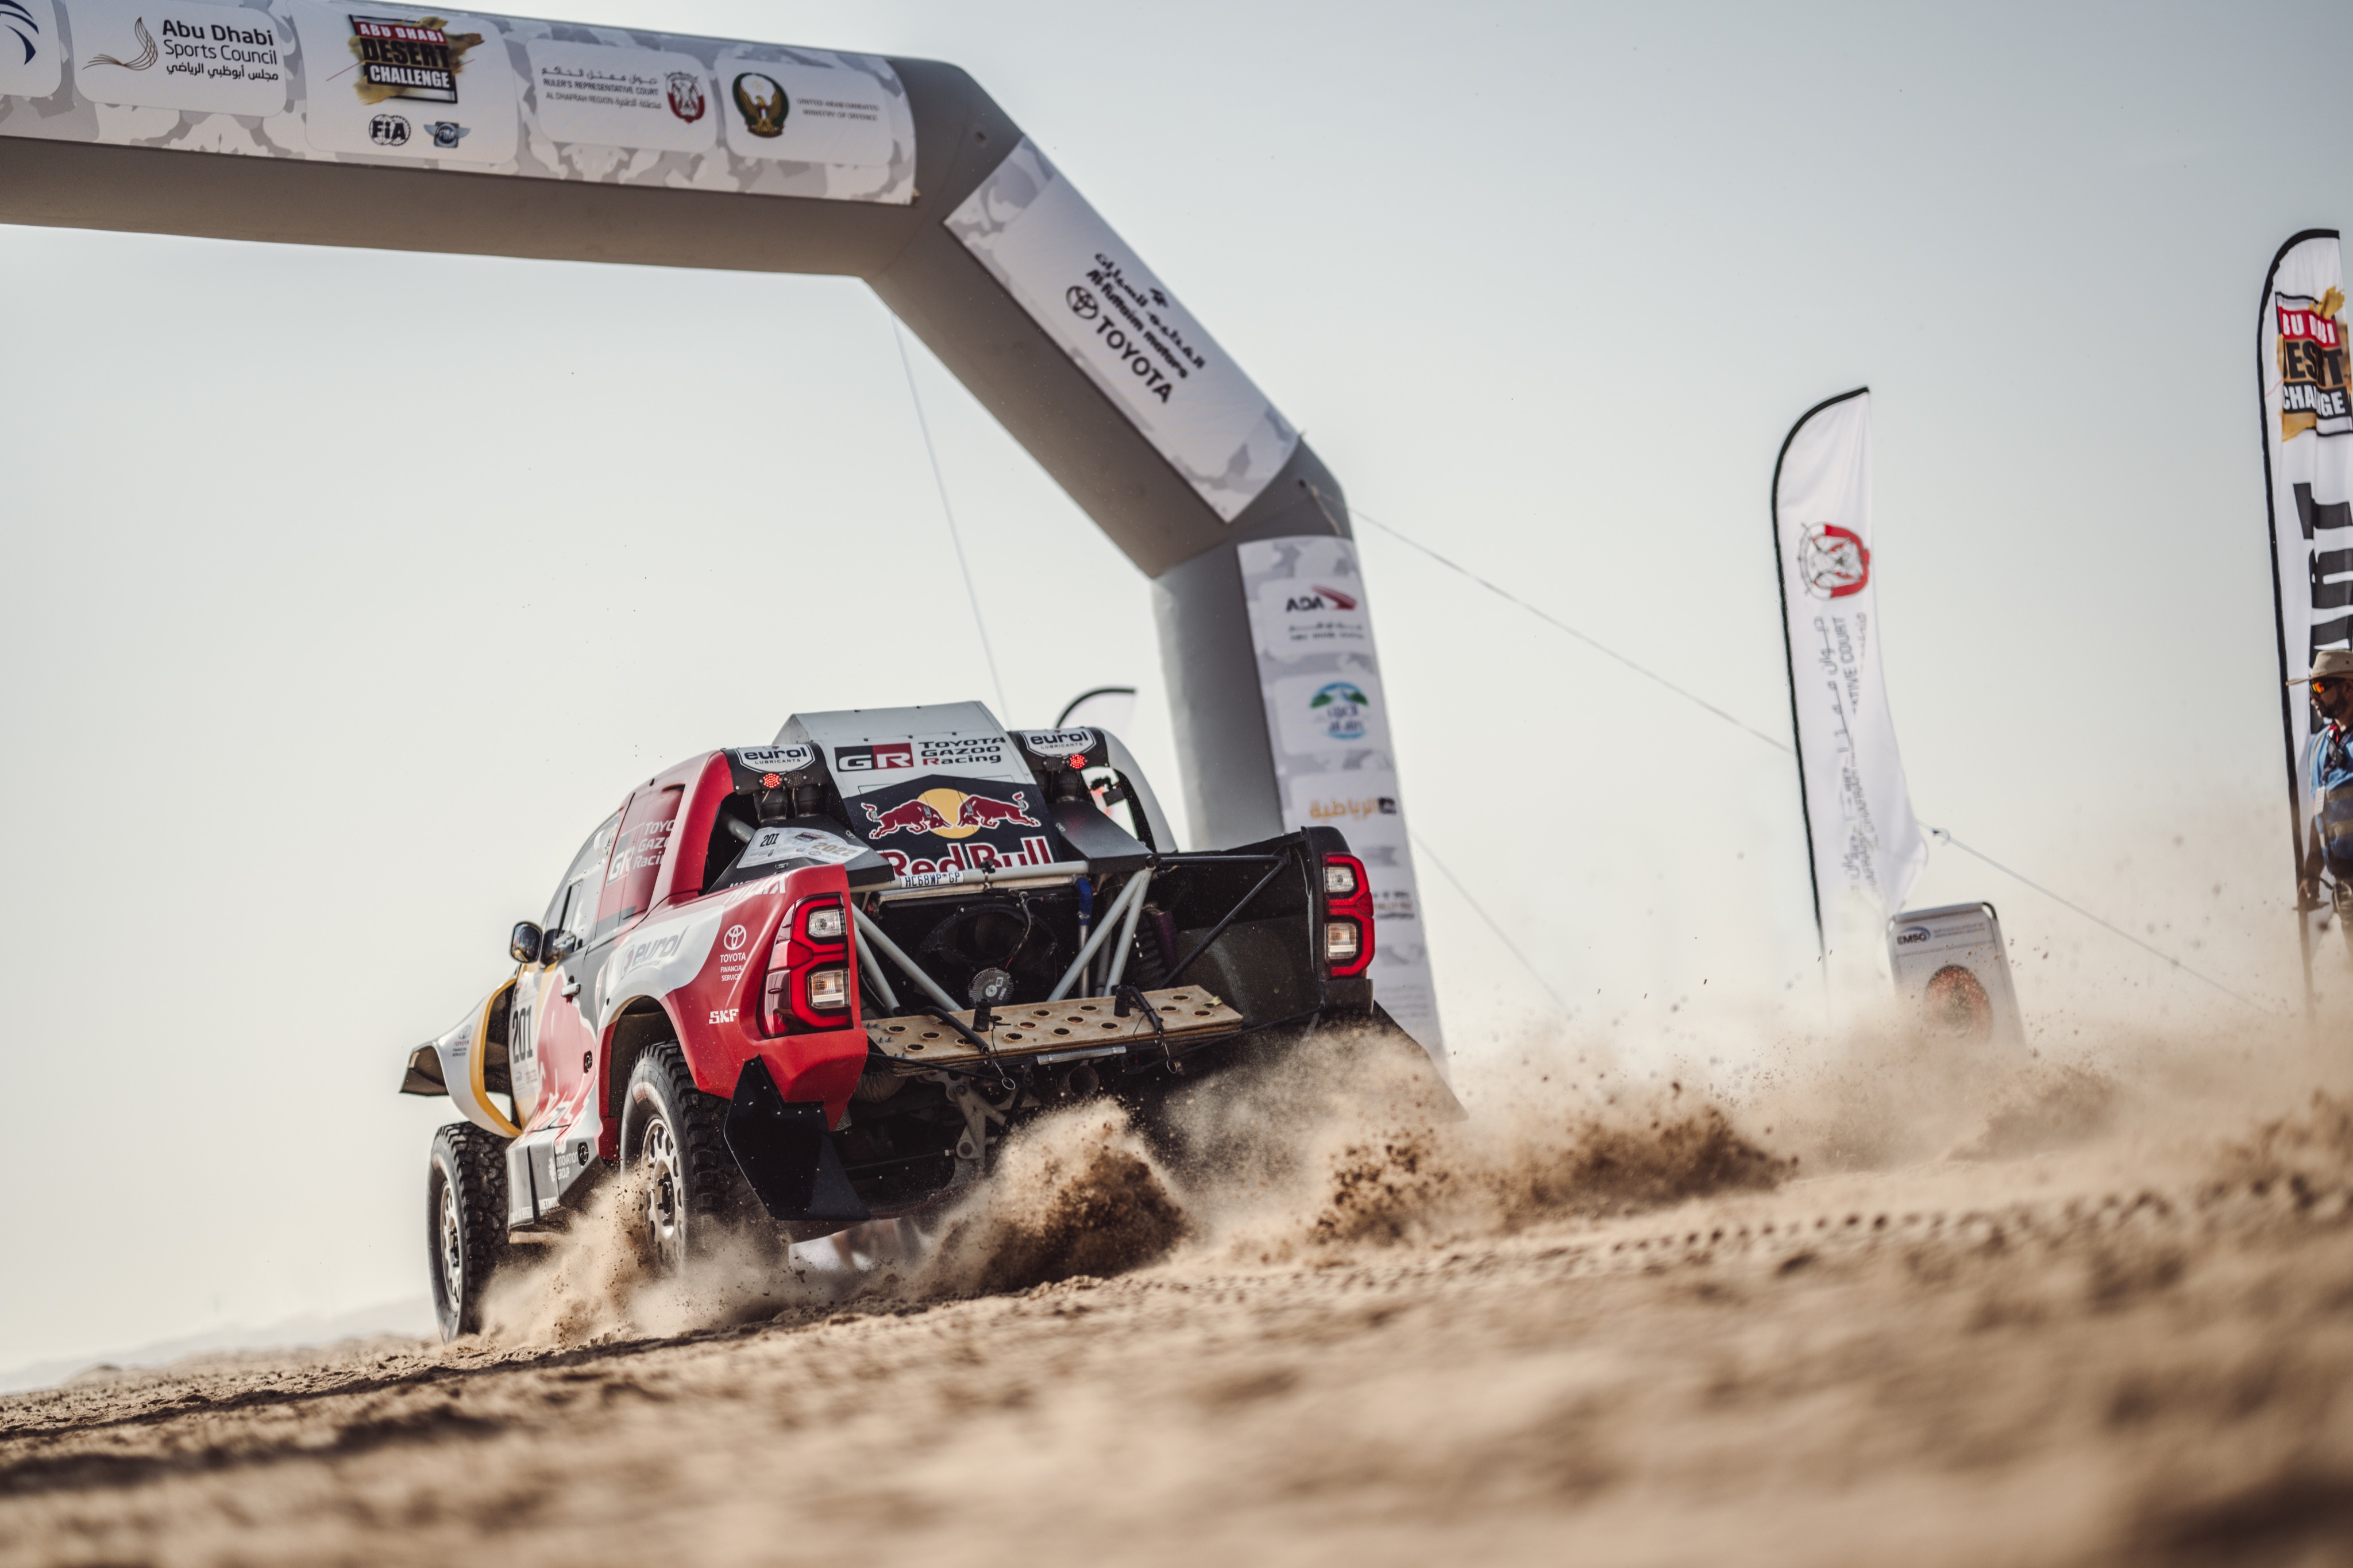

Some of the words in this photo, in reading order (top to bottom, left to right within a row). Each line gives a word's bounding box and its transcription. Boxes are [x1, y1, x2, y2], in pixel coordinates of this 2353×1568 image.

[163, 20, 205, 39] Abu
[211, 25, 274, 46] Dhabi
[360, 24, 391, 37] ABU
[395, 26, 445, 42] DHABI
[164, 39, 217, 59] Sports
[221, 45, 277, 65] Council
[360, 37, 450, 68] DESERT
[166, 61, 204, 76] الرياضي
[248, 69, 279, 82] مجلس
[369, 65, 450, 88] CHALLENGE
[635, 87, 659, 96] COURT
[1097, 315, 1172, 403] TOYOTA
[918, 736, 1006, 748] TOYOTA
[1030, 731, 1089, 745] eurol
[744, 747, 807, 760] eurol
[920, 746, 1001, 757] GAZOO
[838, 752, 912, 771] GR
[923, 755, 1001, 766] Racing
[759, 833, 780, 847] 201
[812, 842, 858, 857] 2022
[949, 872, 961, 883] GP
[720, 952, 746, 963] TOYOTA
[720, 965, 744, 973] FINANCIAL
[708, 1008, 739, 1024] SKF
[512, 1005, 533, 1064] 201
